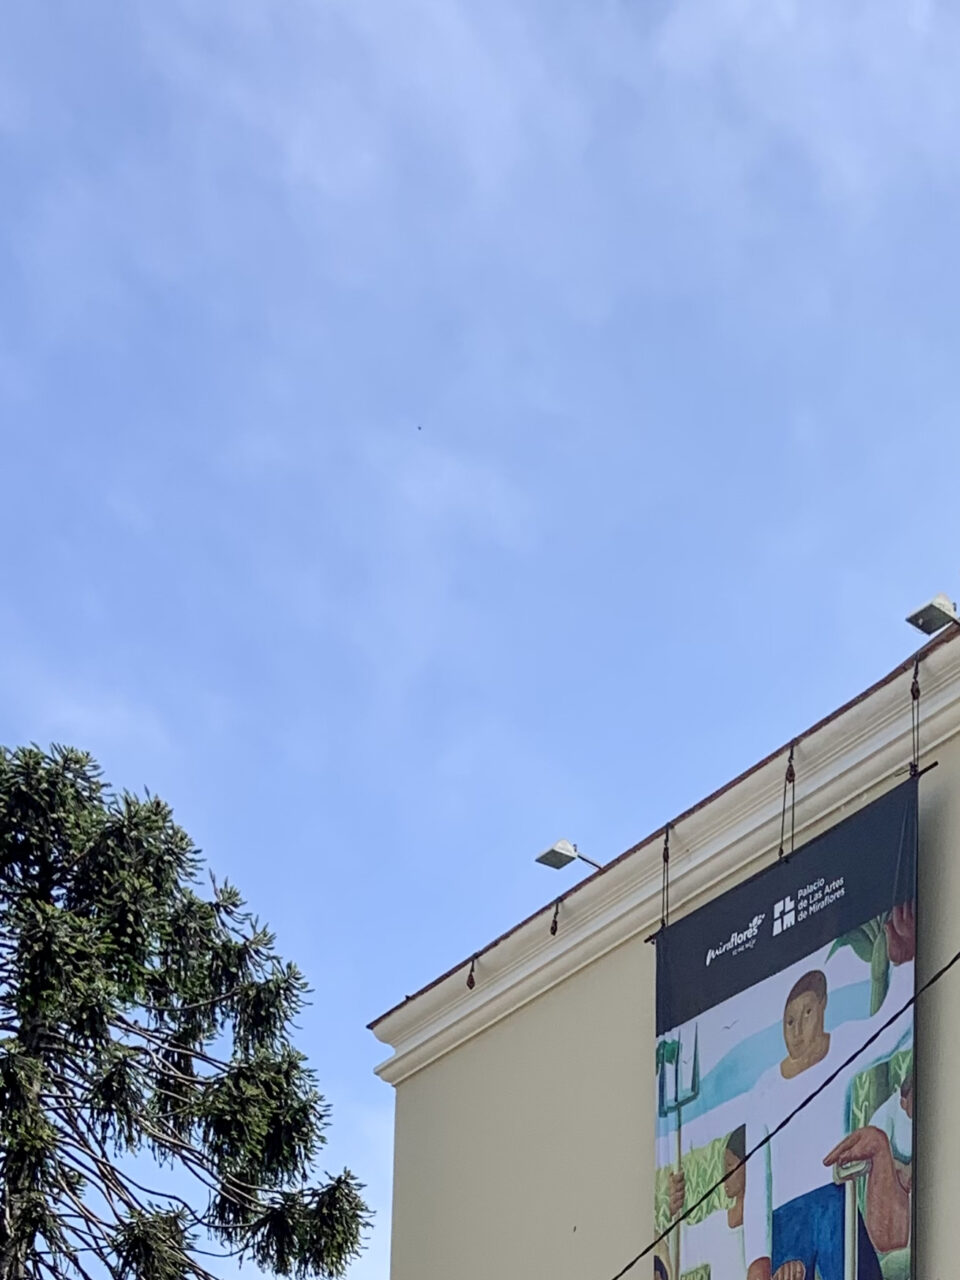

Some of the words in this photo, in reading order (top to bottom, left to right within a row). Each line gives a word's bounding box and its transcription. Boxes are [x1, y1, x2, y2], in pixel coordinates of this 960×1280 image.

[797, 877, 825, 900] Palacio
[797, 899, 808, 910] de
[809, 890, 823, 904] Las
[823, 877, 845, 895] Artes
[797, 910, 808, 922] de
[808, 887, 846, 916] Miraflores
[706, 925, 758, 967] miraflores
